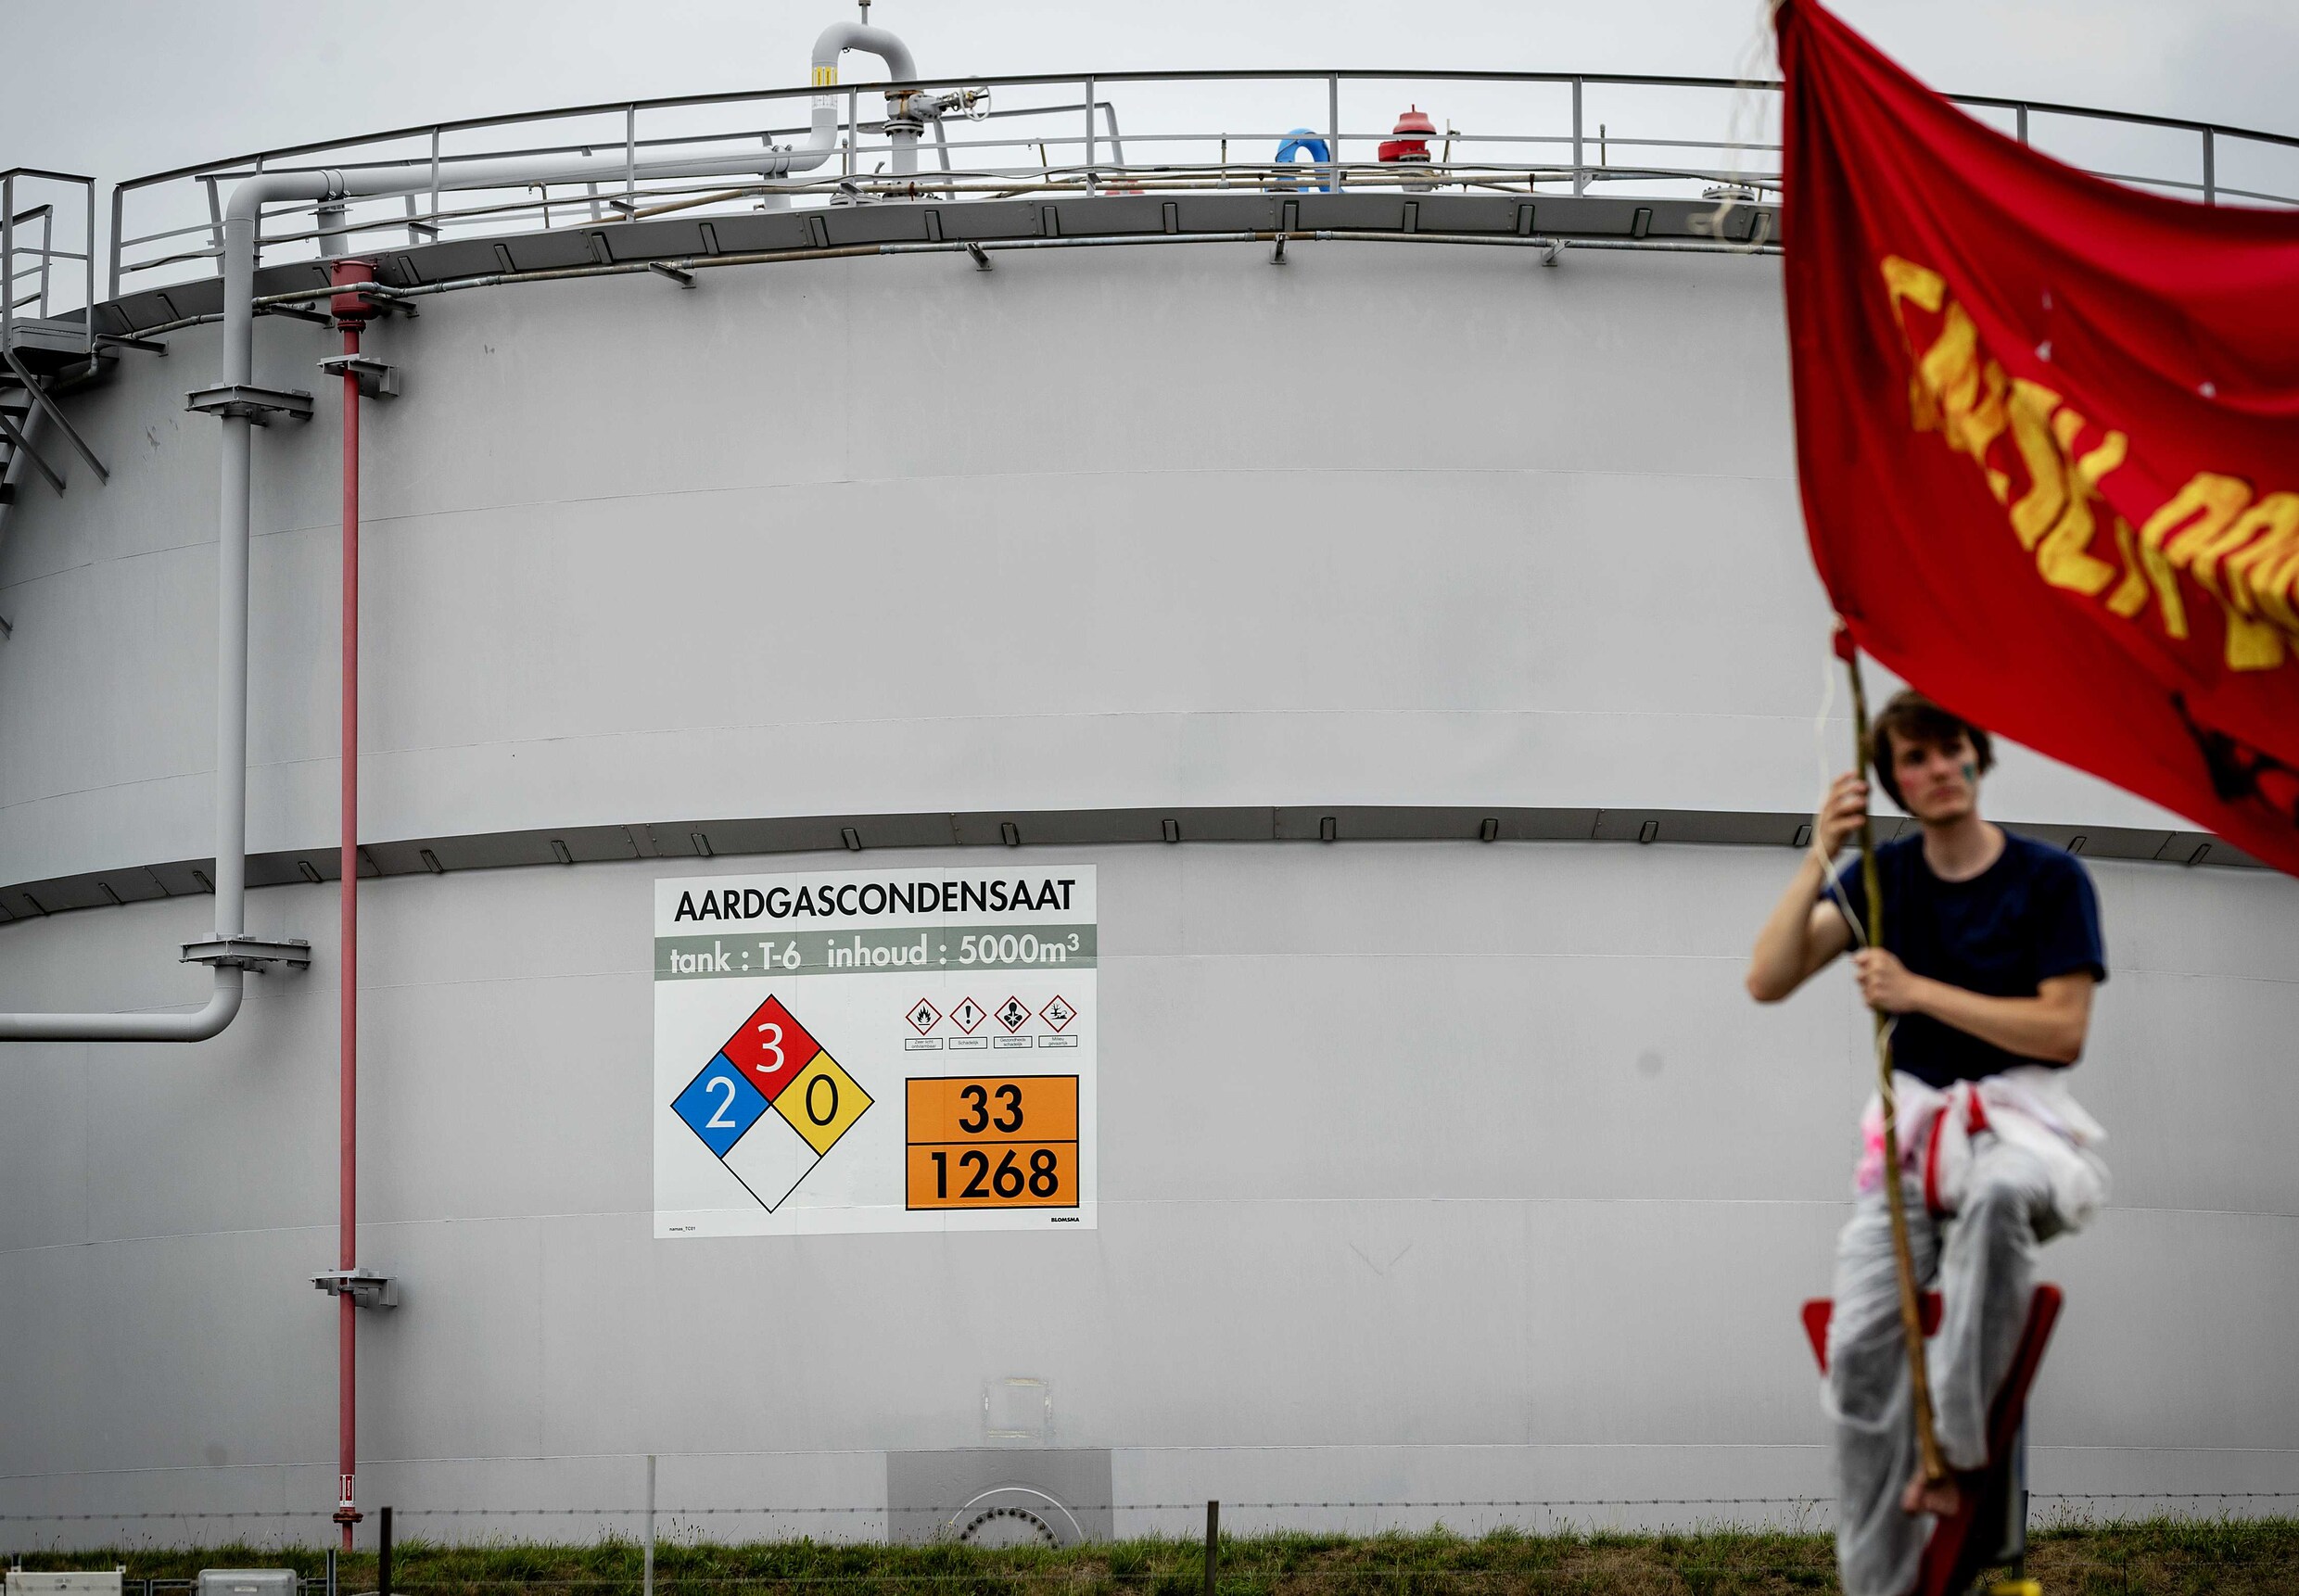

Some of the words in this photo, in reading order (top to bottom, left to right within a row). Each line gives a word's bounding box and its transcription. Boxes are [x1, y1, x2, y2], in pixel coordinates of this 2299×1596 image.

[674, 879, 1076, 922] AARDGASCONDENSAAT
[669, 940, 731, 973] tank
[758, 940, 802, 970] T-6
[828, 933, 928, 968] inhoud
[756, 1021, 785, 1073] 3
[705, 1076, 737, 1129] 2
[805, 1073, 839, 1127] 0
[959, 1083, 1024, 1134] 33
[931, 1148, 1060, 1199] 1268
